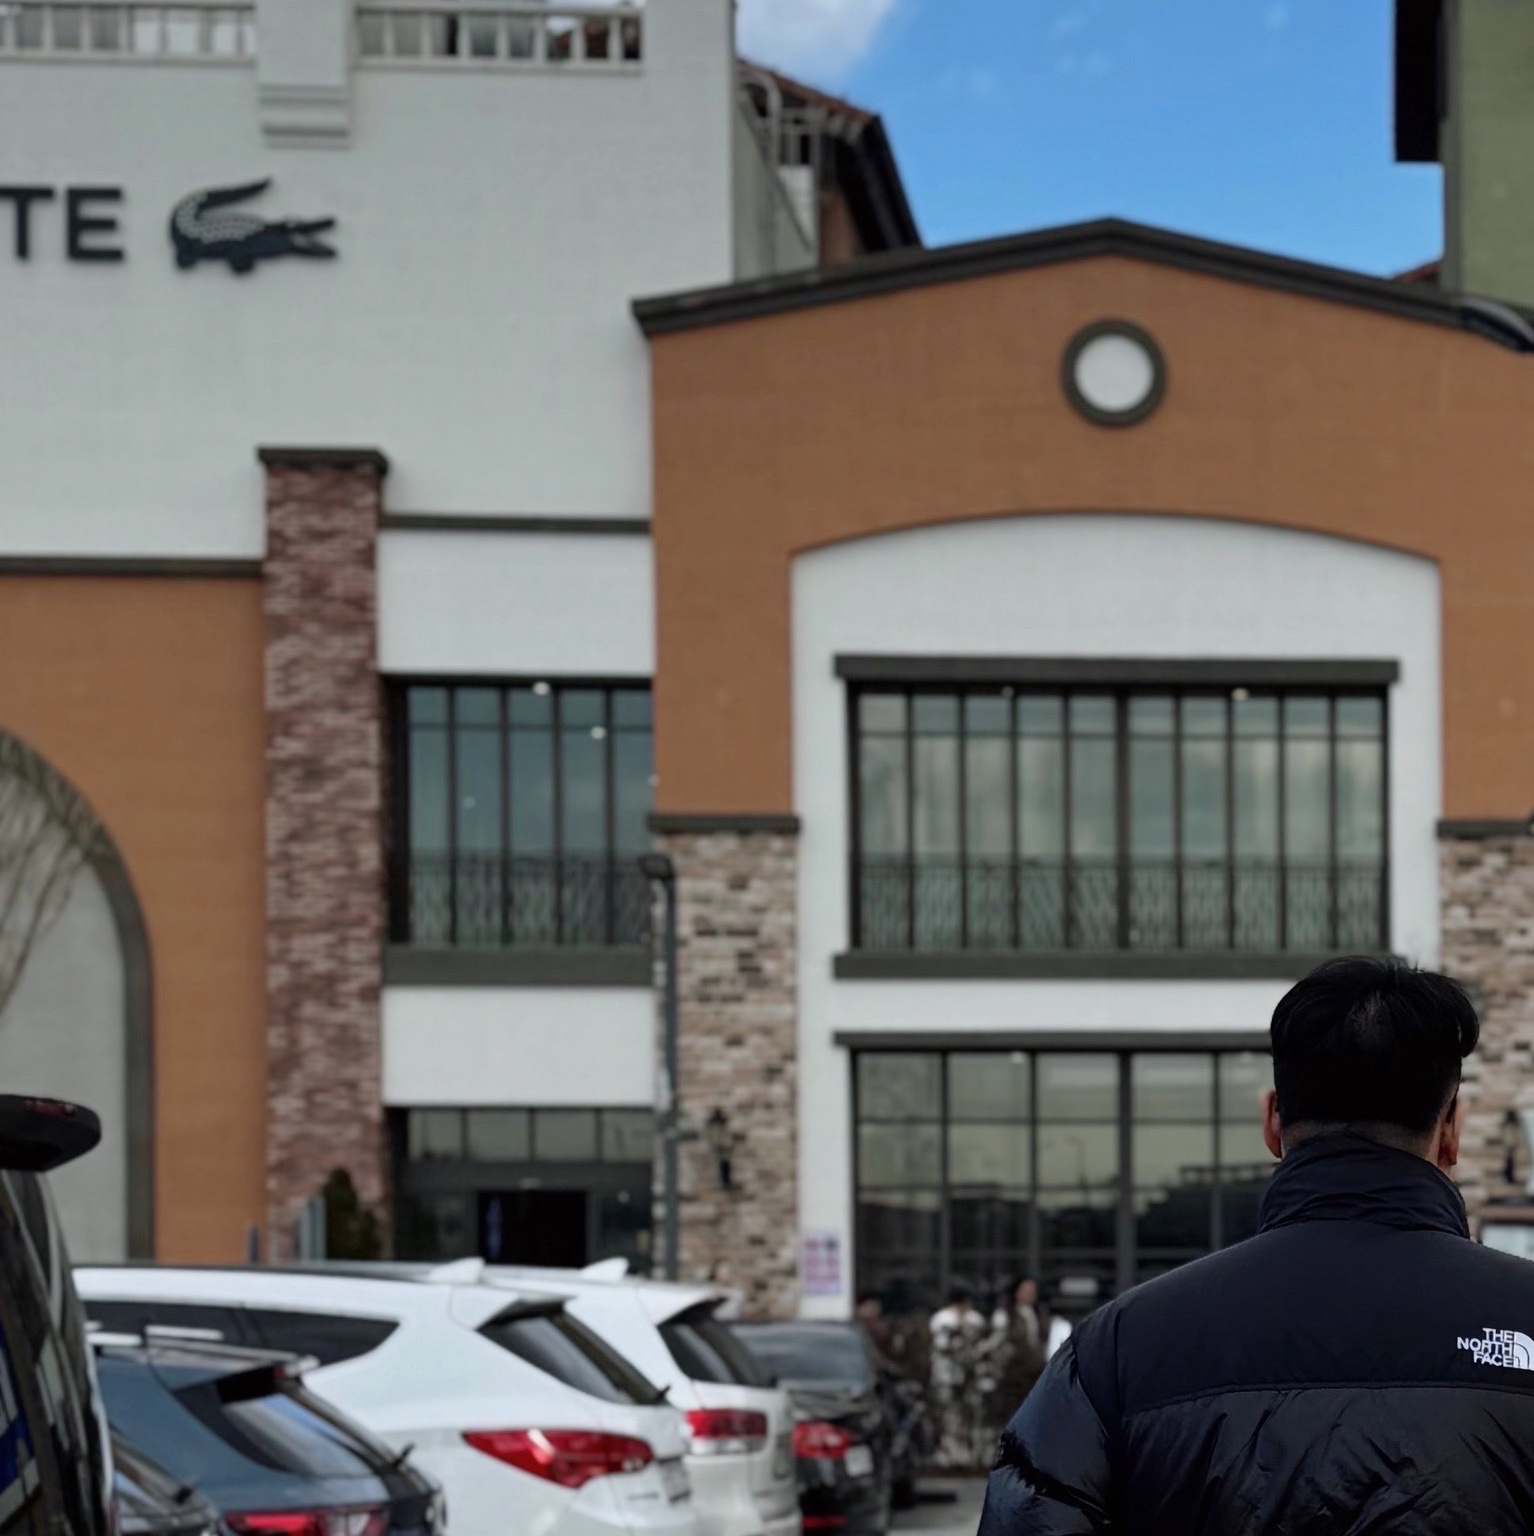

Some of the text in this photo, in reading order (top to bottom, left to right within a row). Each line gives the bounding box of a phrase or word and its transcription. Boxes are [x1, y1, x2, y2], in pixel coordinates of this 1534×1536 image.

[1482, 1327, 1514, 1343] THE
[1456, 1337, 1514, 1357] NORTH
[1473, 1351, 1514, 1368] FACE
